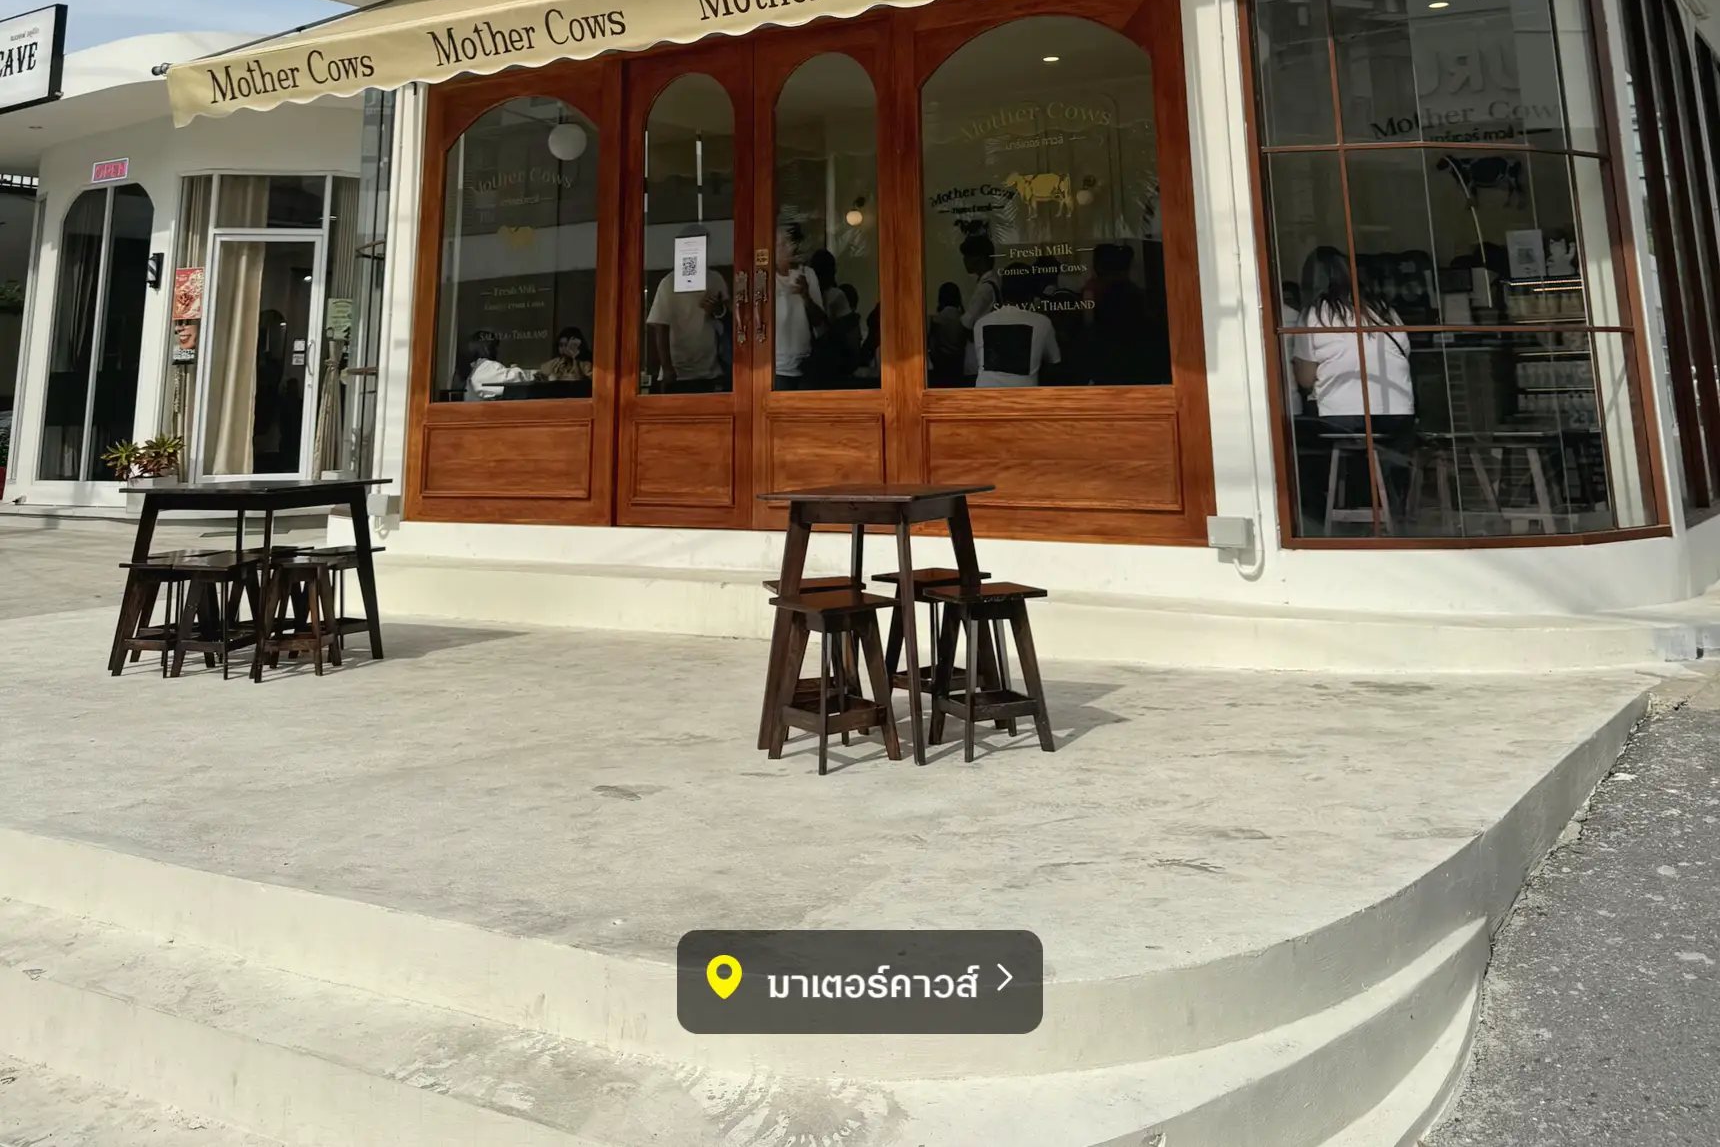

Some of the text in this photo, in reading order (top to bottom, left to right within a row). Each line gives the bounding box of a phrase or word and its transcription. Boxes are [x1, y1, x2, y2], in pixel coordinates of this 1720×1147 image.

[427, 9, 626, 66] Mother Cows
[207, 49, 375, 104] Mother Cows
[958, 101, 1112, 141] Mother Cows
[1488, 100, 1557, 121] Cow
[95, 162, 127, 179] OPEN
[929, 187, 977, 208] Mother
[1009, 244, 1073, 258] Fresh Milk
[997, 263, 1088, 276] Comes From Cows
[1041, 300, 1096, 311] THAILAND
